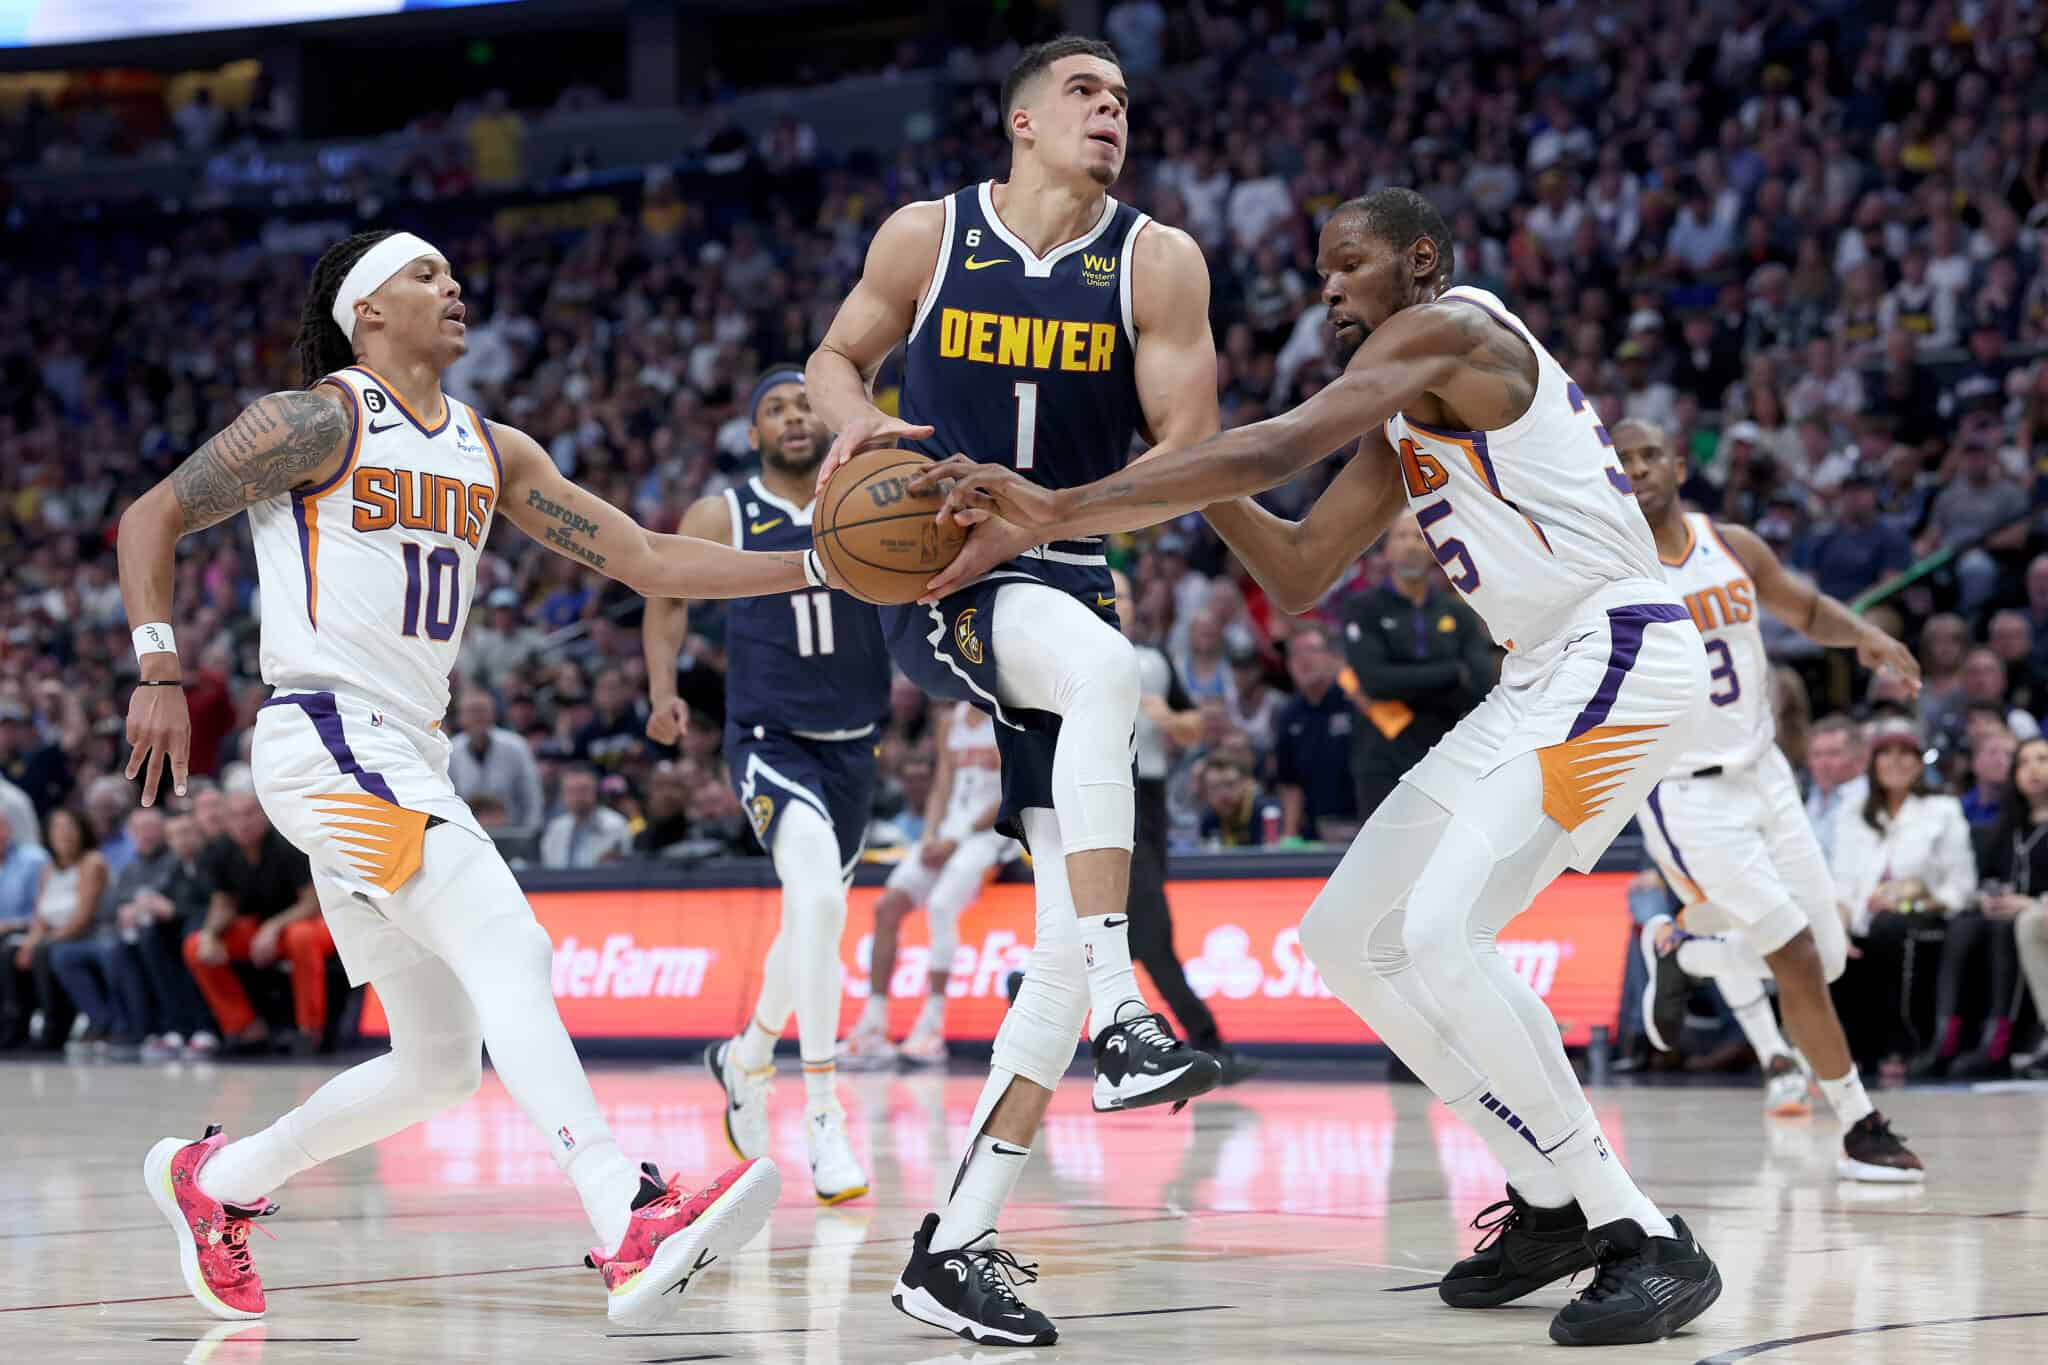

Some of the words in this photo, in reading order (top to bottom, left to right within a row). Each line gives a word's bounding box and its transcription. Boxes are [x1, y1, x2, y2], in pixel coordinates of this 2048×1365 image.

[965, 229, 982, 247] 6
[1083, 253, 1116, 272] WU
[1082, 269, 1115, 281] Western
[1087, 279, 1111, 287] Union
[940, 307, 1117, 373] DENVER
[365, 390, 382, 411] 6
[1013, 380, 1039, 470] 1
[352, 466, 495, 550] SUNS
[526, 487, 601, 539] PERFORM
[400, 542, 461, 643] 10
[790, 592, 835, 658] 11
[1703, 638, 1741, 707] 3
